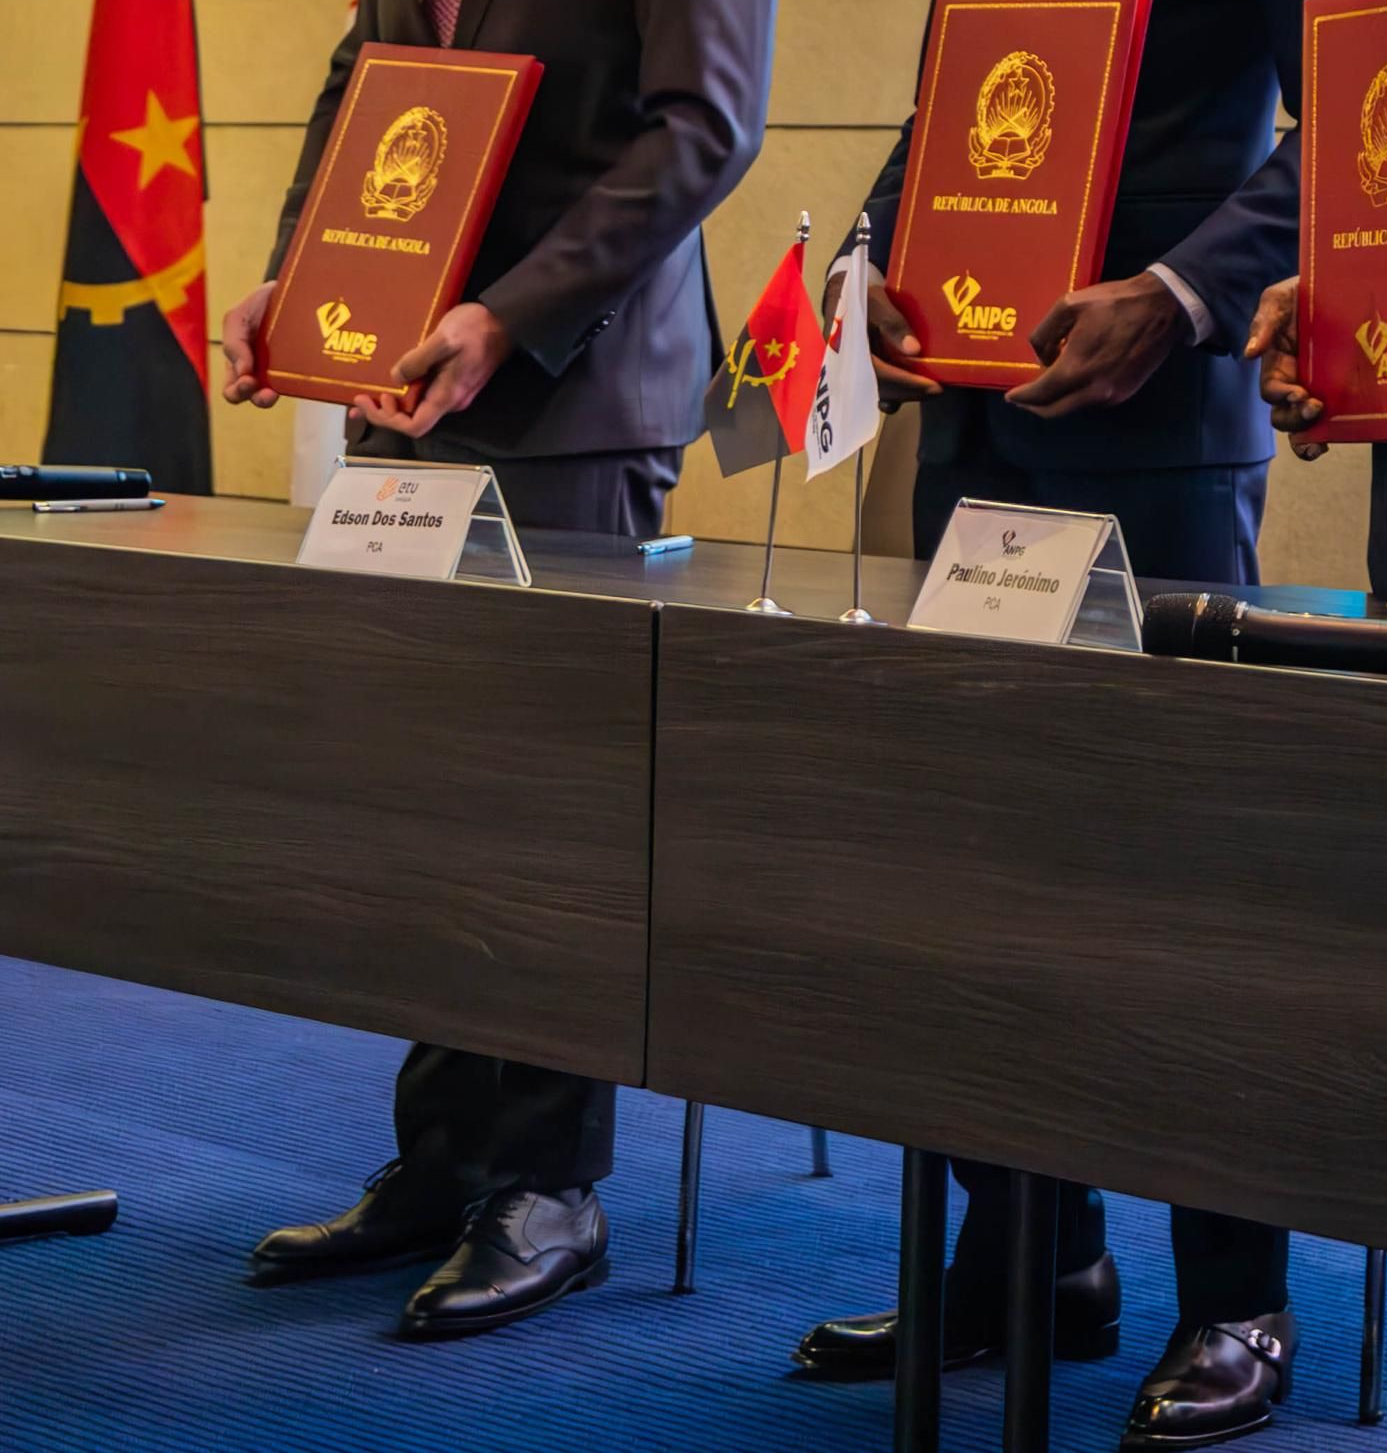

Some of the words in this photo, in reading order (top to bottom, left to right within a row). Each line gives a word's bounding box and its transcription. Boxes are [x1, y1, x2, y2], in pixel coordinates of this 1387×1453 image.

[933, 192, 993, 212] REPÚBLICA
[994, 198, 1011, 213] DE
[1011, 198, 1057, 215] ANGOLA
[958, 305, 1017, 331] ANPG
[324, 329, 377, 356] ANPG
[815, 364, 833, 453] NPG
[332, 510, 370, 525] Edson
[371, 510, 396, 526] Dos
[398, 511, 443, 528] Santos
[366, 541, 383, 553] PCA
[946, 563, 996, 585] Paulino
[997, 568, 1059, 593] Jerónimo
